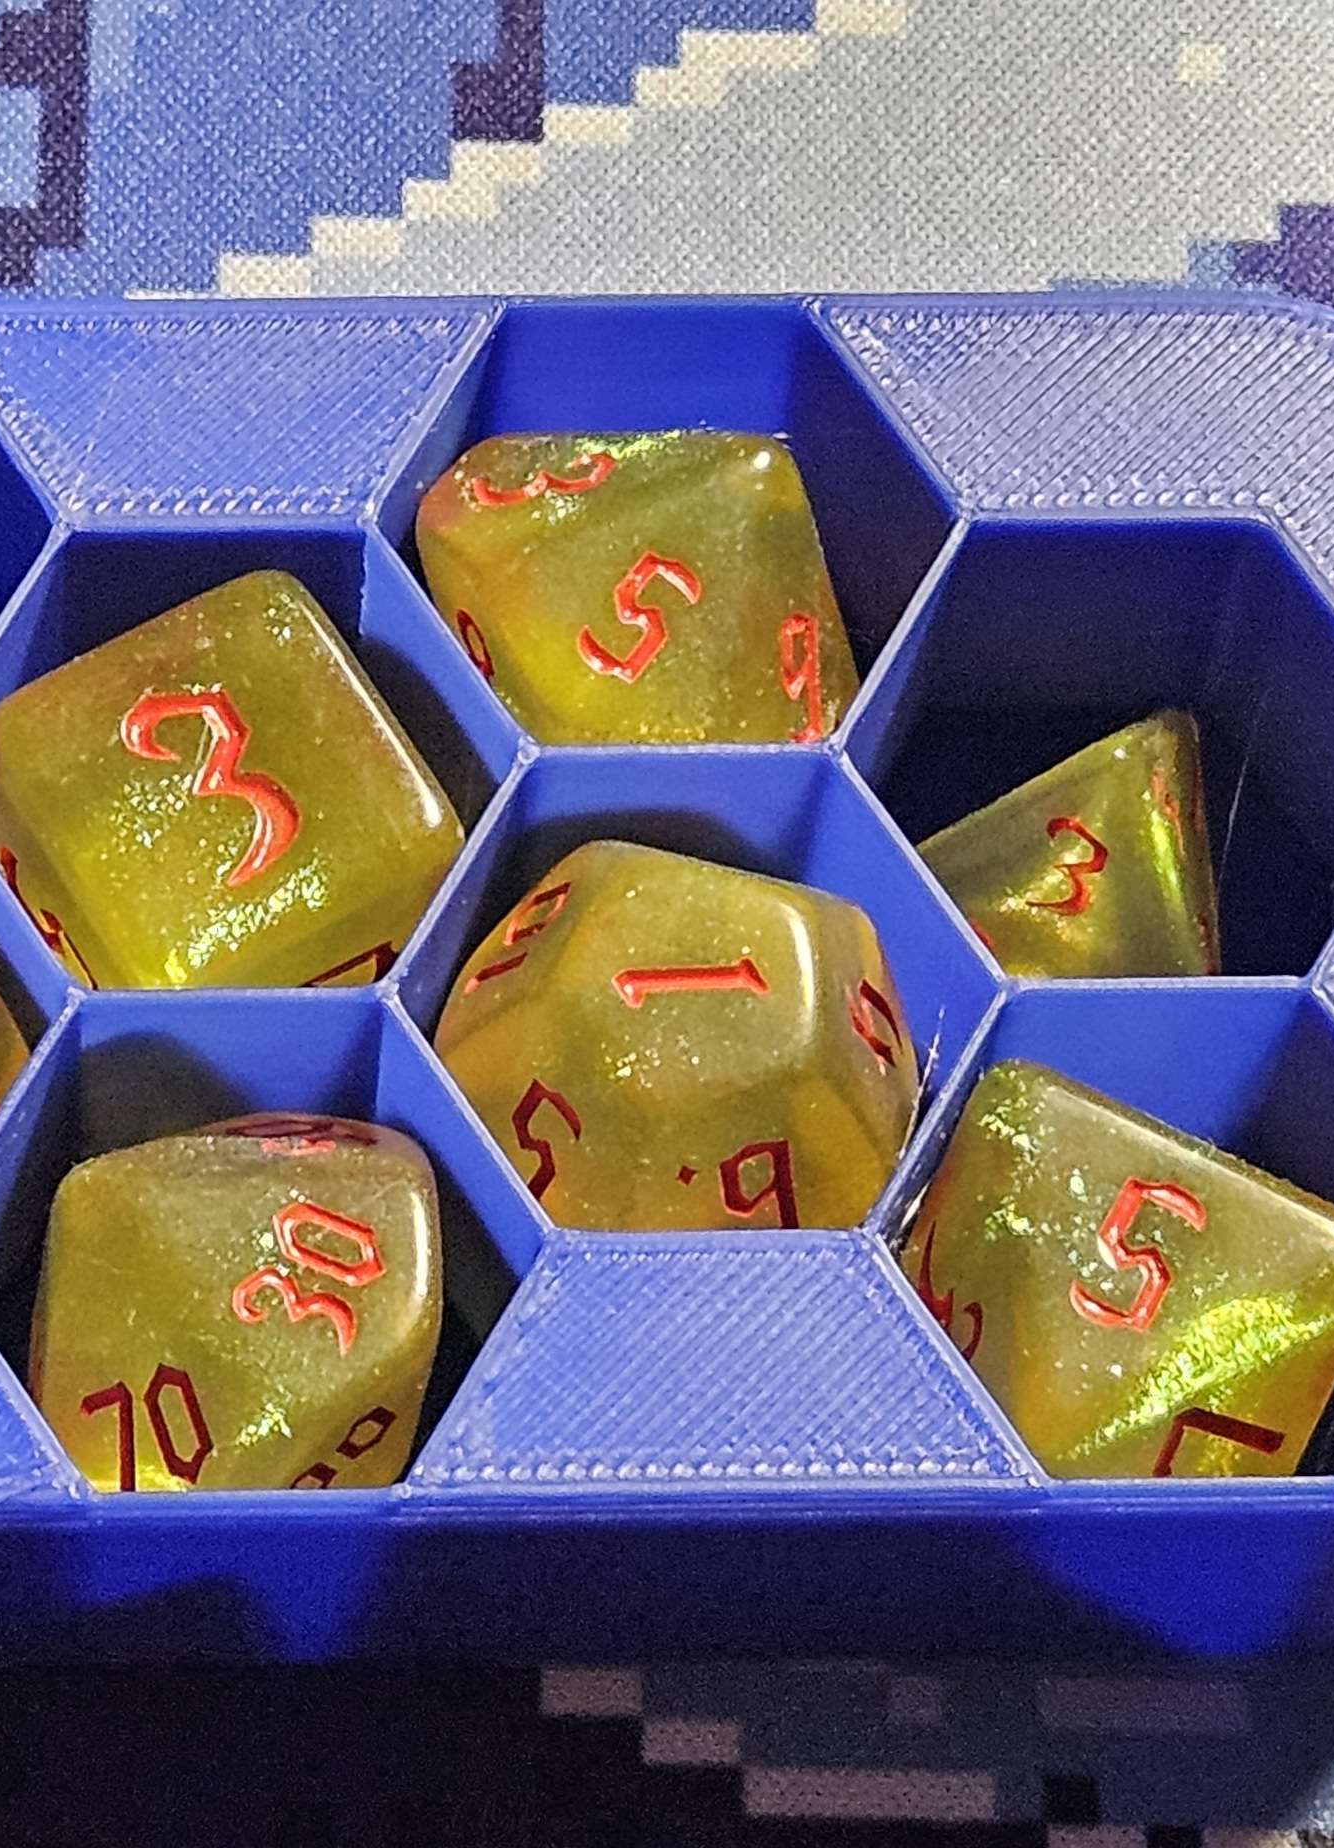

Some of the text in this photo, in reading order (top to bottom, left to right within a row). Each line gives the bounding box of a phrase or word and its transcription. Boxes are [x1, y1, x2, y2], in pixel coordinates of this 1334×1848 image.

[577, 550, 702, 684] 5
[121, 686, 300, 888] 3
[1026, 816, 1109, 917] 3
[612, 956, 770, 1009] 1
[233, 1200, 387, 1358] 30
[1068, 1175, 1209, 1333] 5
[80, 1363, 214, 1492] 70
